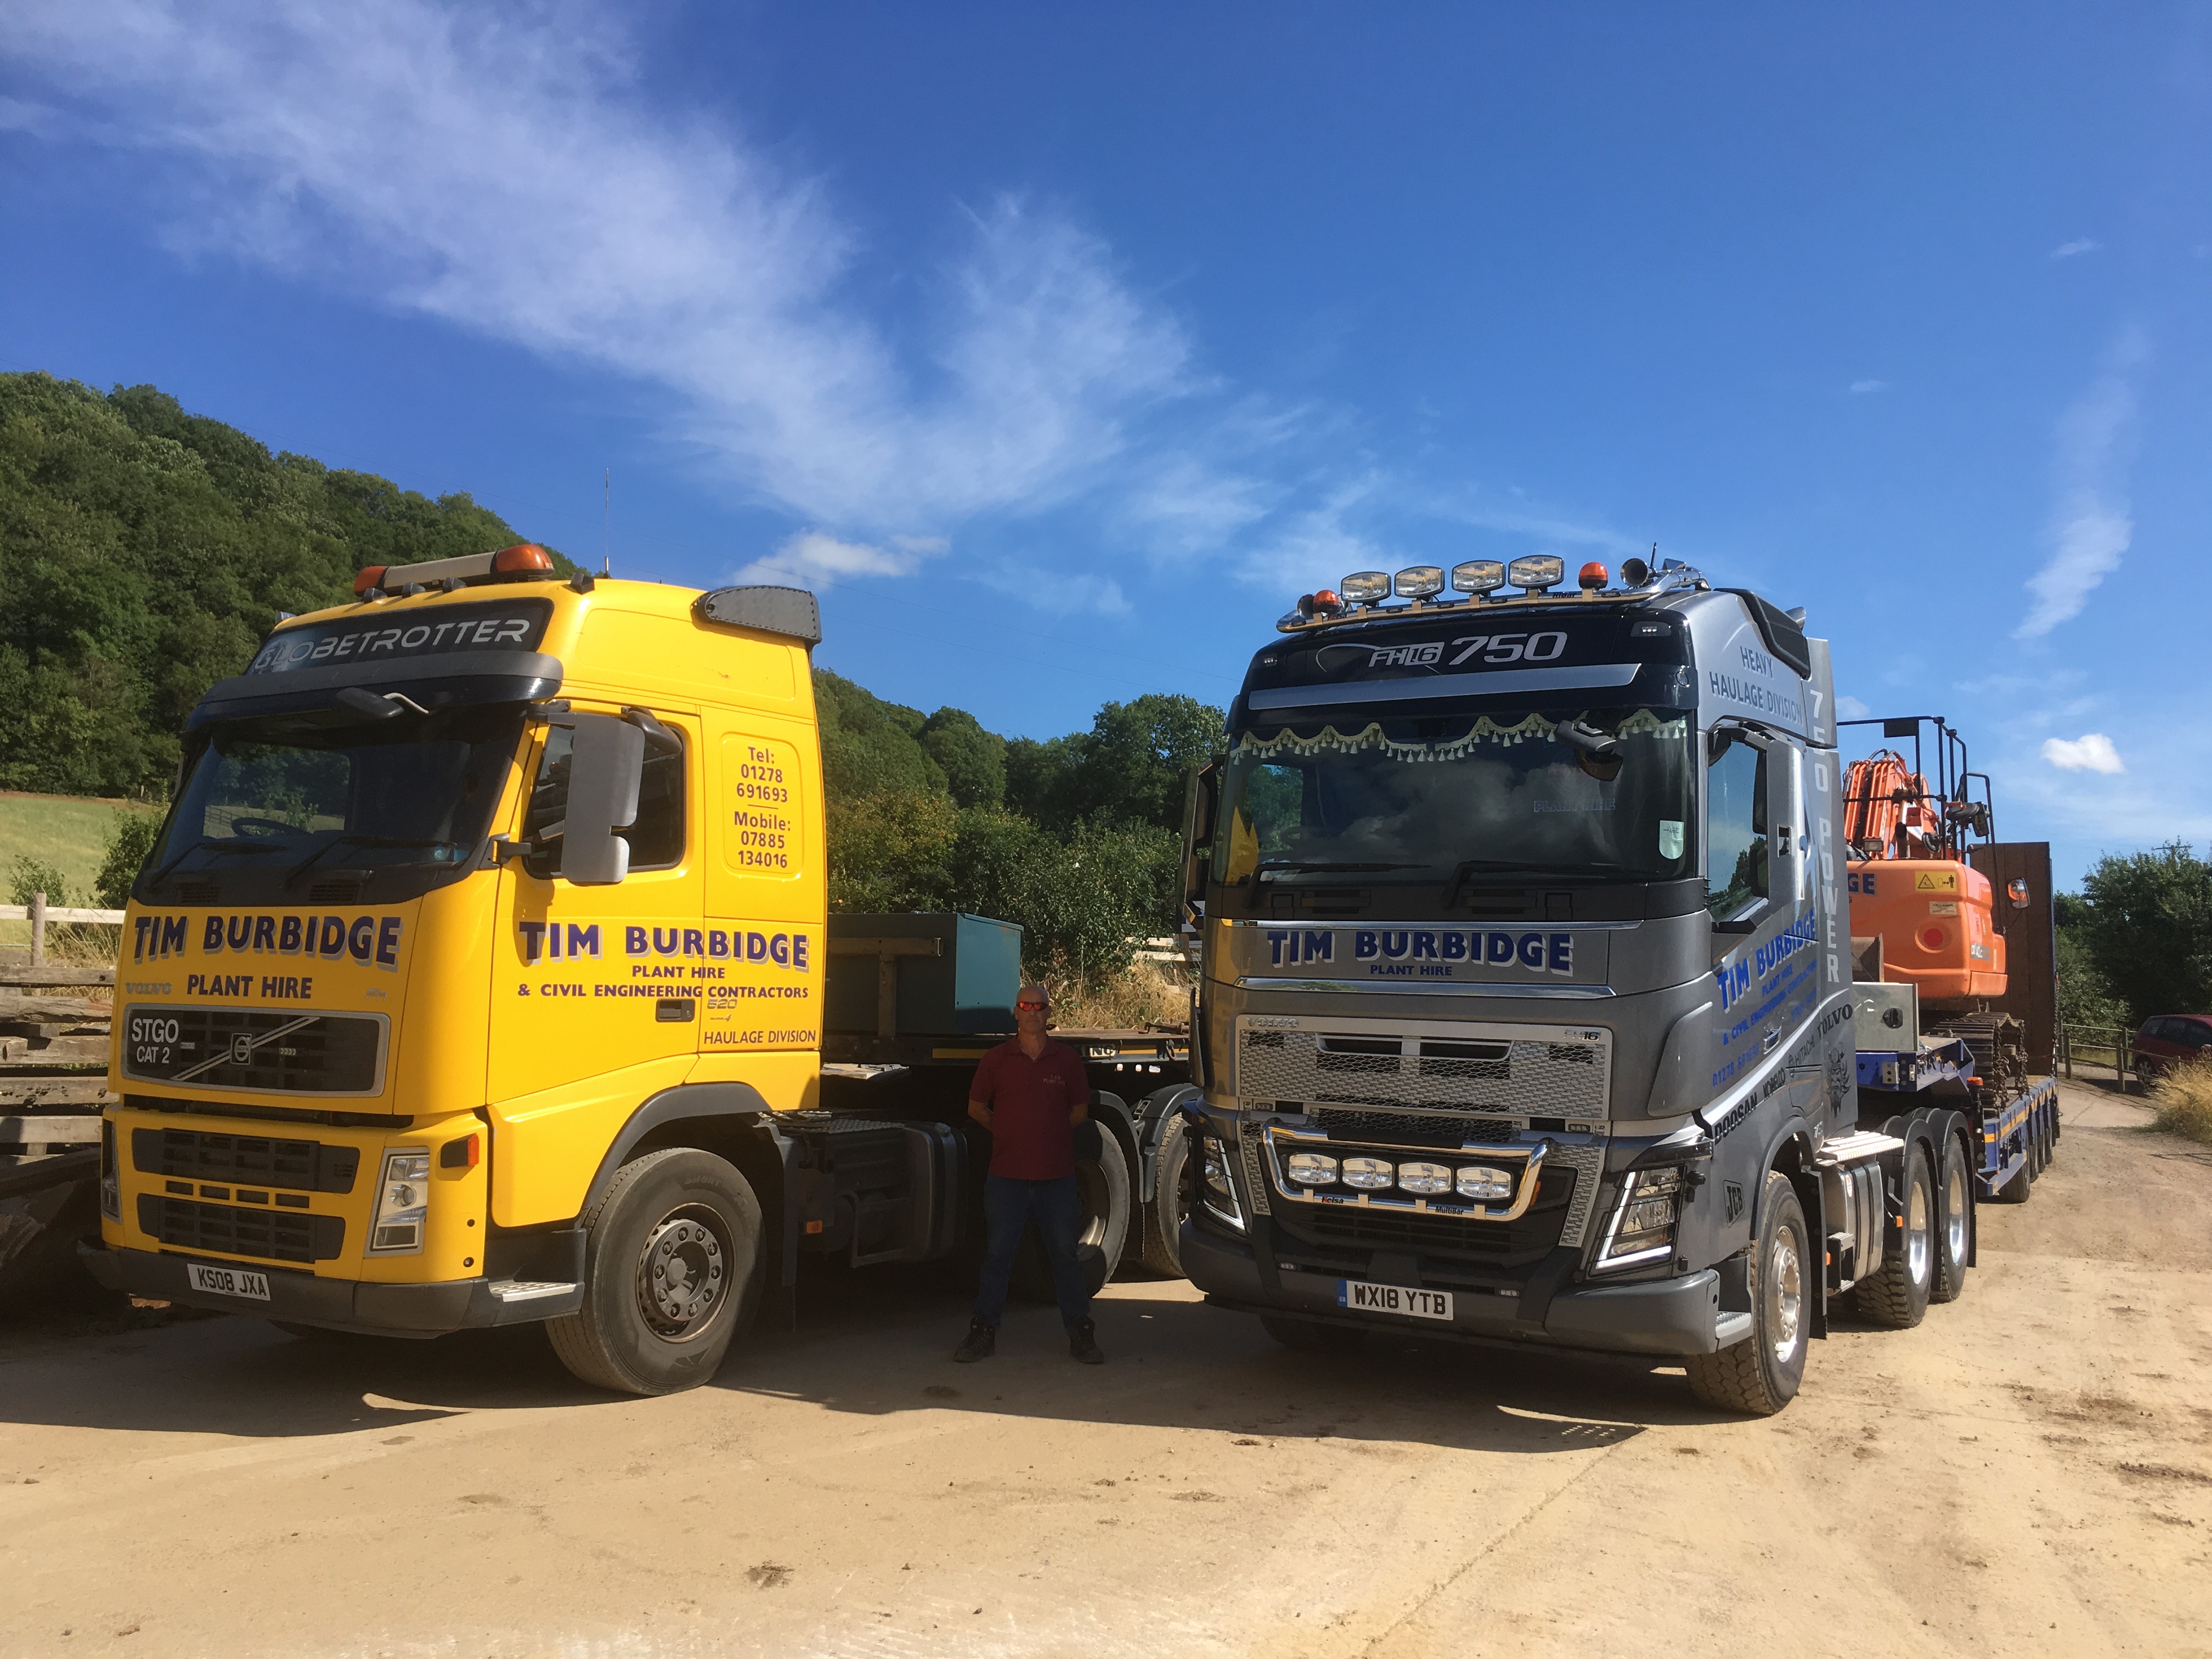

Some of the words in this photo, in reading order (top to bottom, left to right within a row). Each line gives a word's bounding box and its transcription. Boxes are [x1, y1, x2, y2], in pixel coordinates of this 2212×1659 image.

[255, 619, 531, 669] GLOBETROTTER
[1369, 642, 1444, 667] FH16
[1448, 631, 1567, 665] 750
[1740, 646, 1774, 680] HEAVY
[1709, 672, 1764, 711] HAULAGE
[1767, 690, 1805, 727] DIVISION
[1810, 690, 1829, 792] 750
[748, 746, 775, 764] Tel:
[741, 764, 783, 783] 01278
[736, 782, 788, 803] 691693
[734, 811, 791, 831] Mobile:
[741, 831, 785, 849] 07885
[738, 850, 788, 868] 134016
[1819, 817, 1840, 983] POWER
[134, 916, 188, 964] TIM
[203, 915, 403, 973] BURBIDGE
[519, 922, 603, 965] TIM
[625, 926, 809, 973] BURBIDGE
[1267, 931, 1335, 968] TIM
[1355, 931, 1573, 977] BURBIDGE
[632, 966, 685, 978] PLANT
[691, 967, 725, 979] HIRE
[1370, 964, 1414, 975] PLANT
[1420, 965, 1452, 976] HIRE
[1717, 958, 1752, 1014] TIM
[1756, 908, 1816, 980] BURBIDGE
[125, 983, 172, 994] VOLVO
[187, 974, 253, 996] PLANT
[261, 977, 313, 998] HIRE
[517, 984, 531, 996] &
[540, 984, 586, 996] CIVIL
[594, 984, 702, 998] ENGINEERING
[708, 986, 808, 998] CONTRACTORS
[707, 998, 737, 1009] 520
[132, 1018, 179, 1043] STGO
[1245, 1017, 1300, 1028] VOLVO
[1817, 1003, 1853, 1039] VOLVO
[704, 1031, 764, 1044] HAULAGE
[768, 1030, 816, 1043] DIVISION
[137, 1046, 159, 1063] CAT
[162, 1047, 170, 1064] 2
[1795, 1035, 1816, 1066] HITACHI
[1714, 1092, 1758, 1146] DOOSAN
[1435, 1206, 1464, 1215] MultiBar
[1725, 1186, 1743, 1222] JCB
[198, 1268, 235, 1291] KS08
[239, 1274, 267, 1296] JXA
[1355, 1285, 1399, 1309] WX18
[1405, 1290, 1446, 1315] YTB
